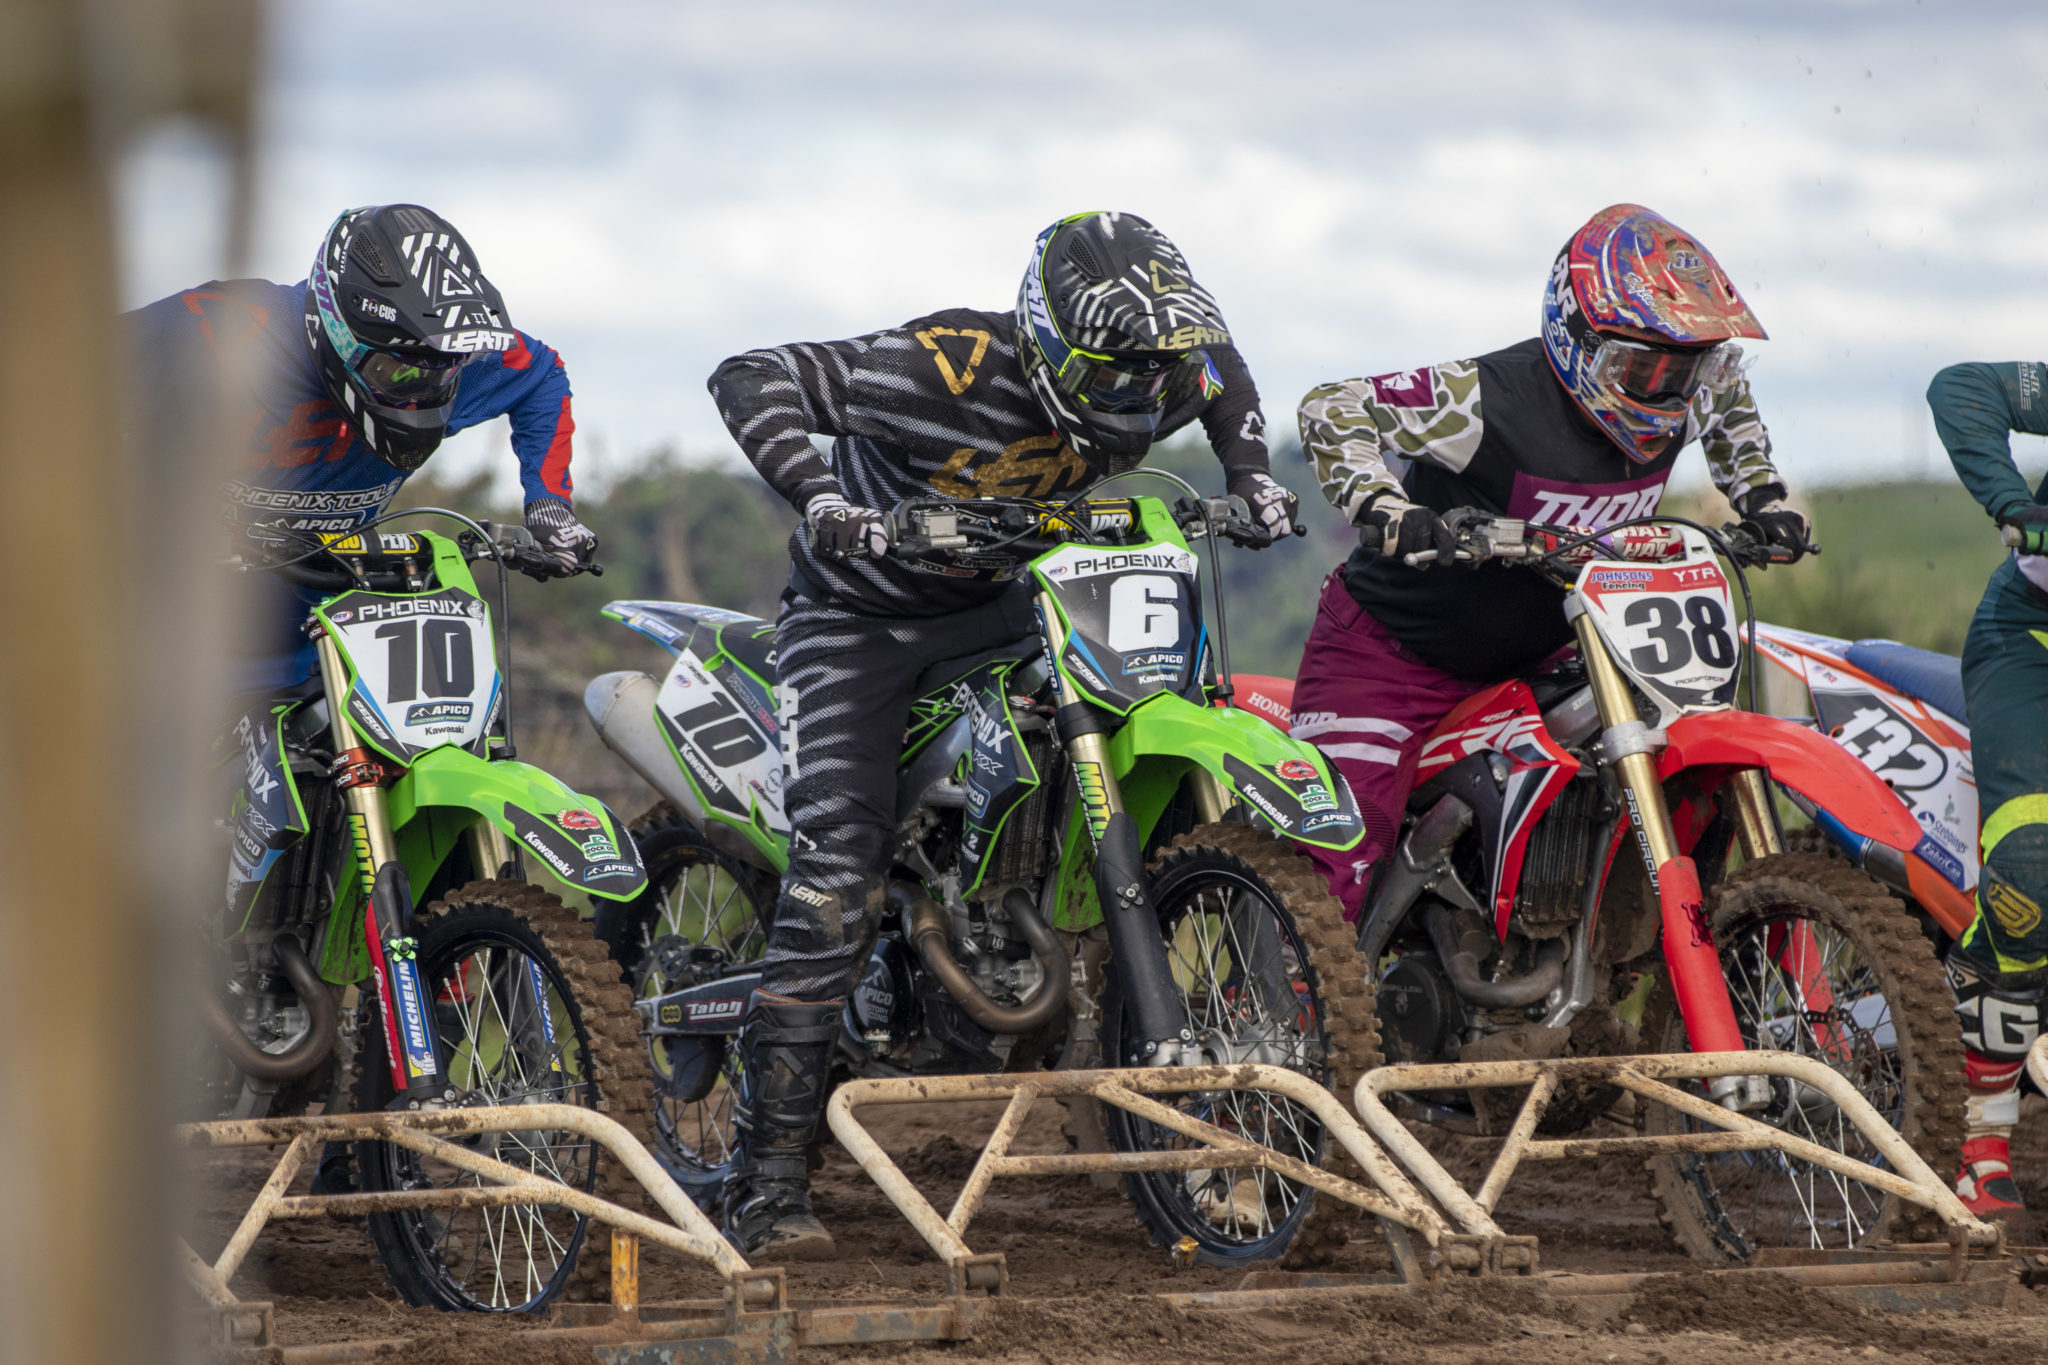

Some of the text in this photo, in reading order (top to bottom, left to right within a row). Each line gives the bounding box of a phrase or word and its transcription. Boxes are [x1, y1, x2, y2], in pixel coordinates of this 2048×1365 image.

[440, 330, 515, 352] LEATT
[1157, 326, 1232, 350] LEATT
[1530, 483, 1664, 527] THOR
[291, 517, 354, 532] APICO
[1075, 554, 1177, 575] PHOENIX
[1673, 567, 1717, 583] YTR
[1591, 571, 1653, 583] JOHNSONS
[1602, 581, 1646, 590] Fencing
[358, 599, 466, 621] PHOENIX
[1108, 574, 1179, 653] 6
[1624, 596, 1736, 675] 38
[375, 618, 475, 704] 10
[1147, 654, 1184, 664] APICO
[1138, 673, 1178, 685] Kawasaki
[432, 705, 470, 715] APICO
[1248, 692, 1290, 721] HOND
[425, 725, 464, 736] Kawasaki
[673, 691, 767, 768] 10
[1835, 707, 1944, 788] 132
[679, 743, 724, 794] Kawasaki
[1243, 784, 1294, 829] Kawasaki
[1322, 814, 1352, 822] APICO
[1624, 787, 1643, 826] PRO
[524, 831, 574, 877] Kawasaki
[789, 882, 832, 907] LEATT
[398, 962, 425, 1049] MICHELIN
